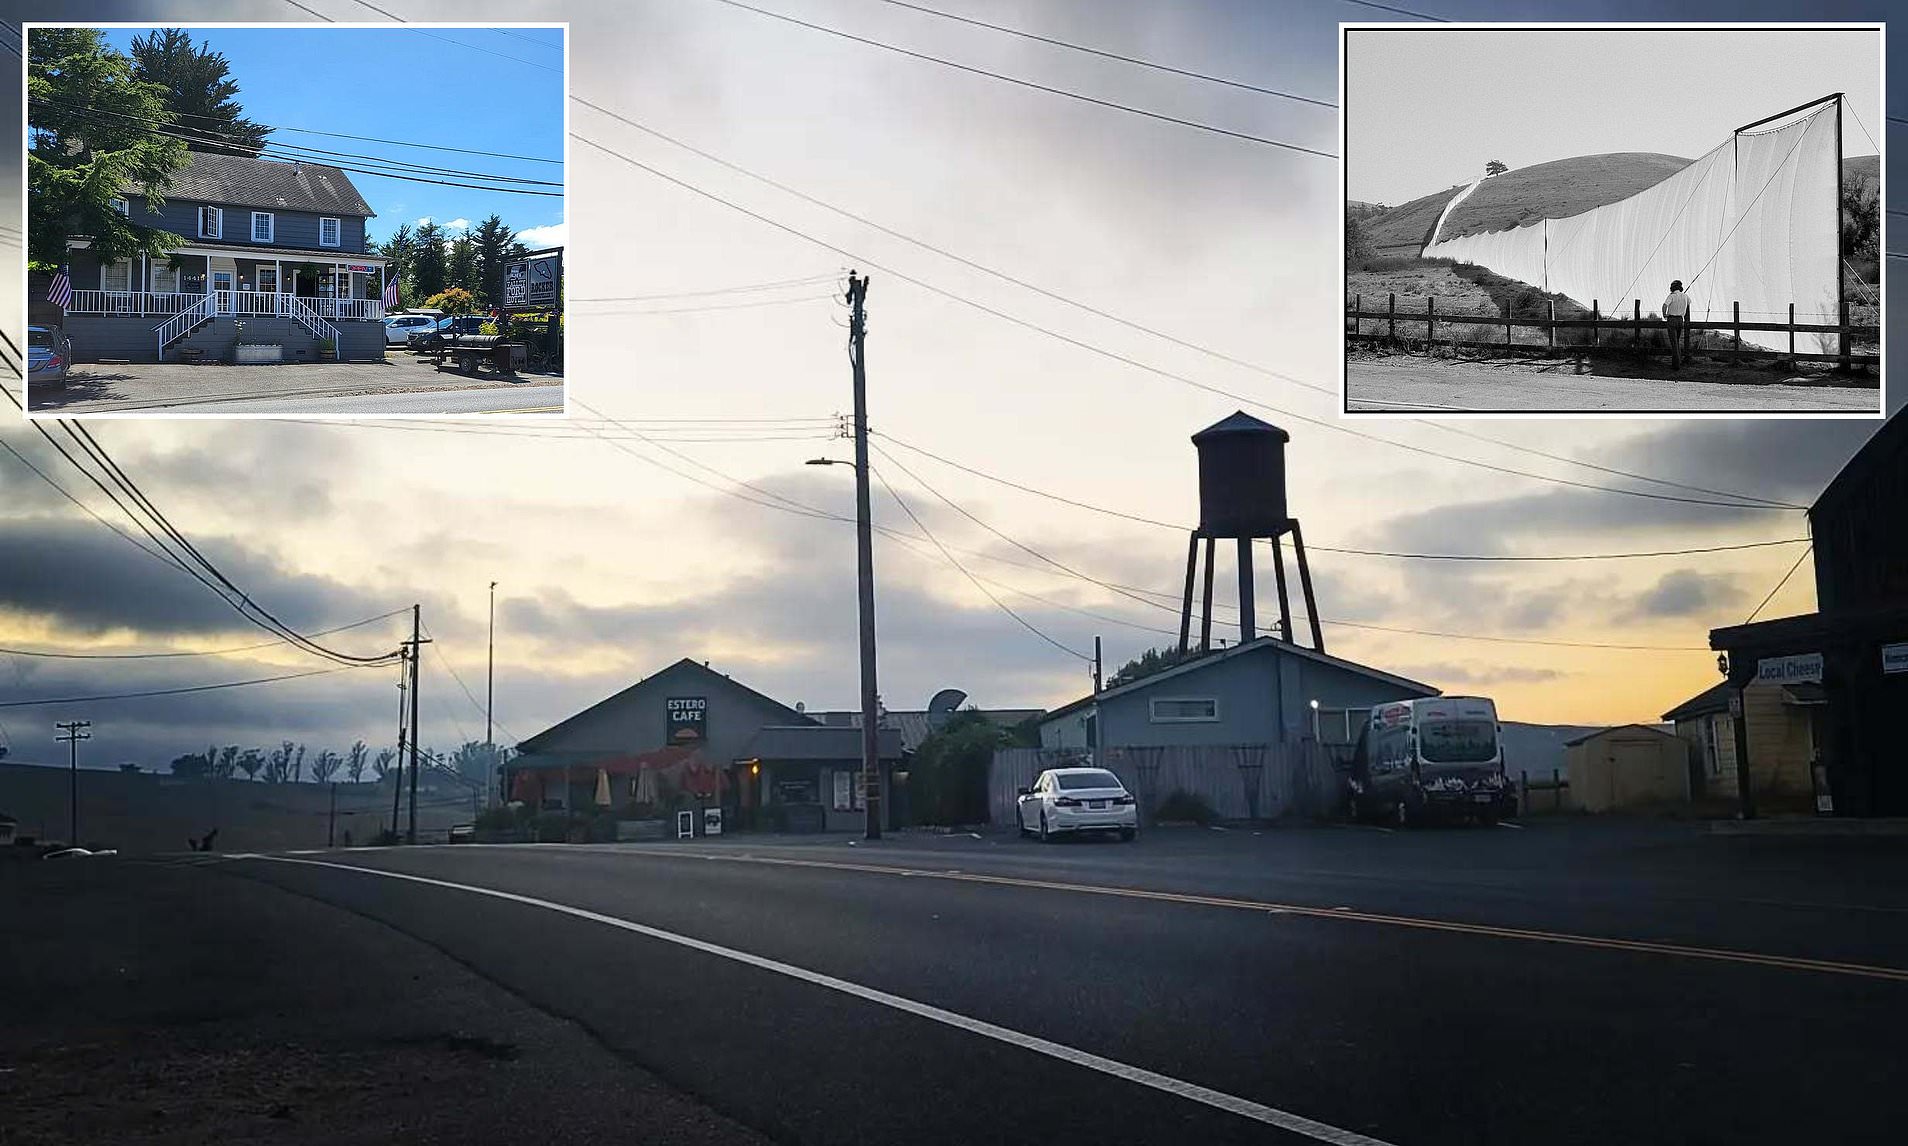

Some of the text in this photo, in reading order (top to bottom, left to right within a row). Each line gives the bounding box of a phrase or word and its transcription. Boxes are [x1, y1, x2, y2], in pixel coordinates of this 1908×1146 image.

[506, 286, 526, 296] FORD
[506, 295, 526, 303] HOTEL
[1759, 663, 1785, 681] Local
[668, 699, 705, 709] ESTERO
[672, 711, 701, 721] CAFE
